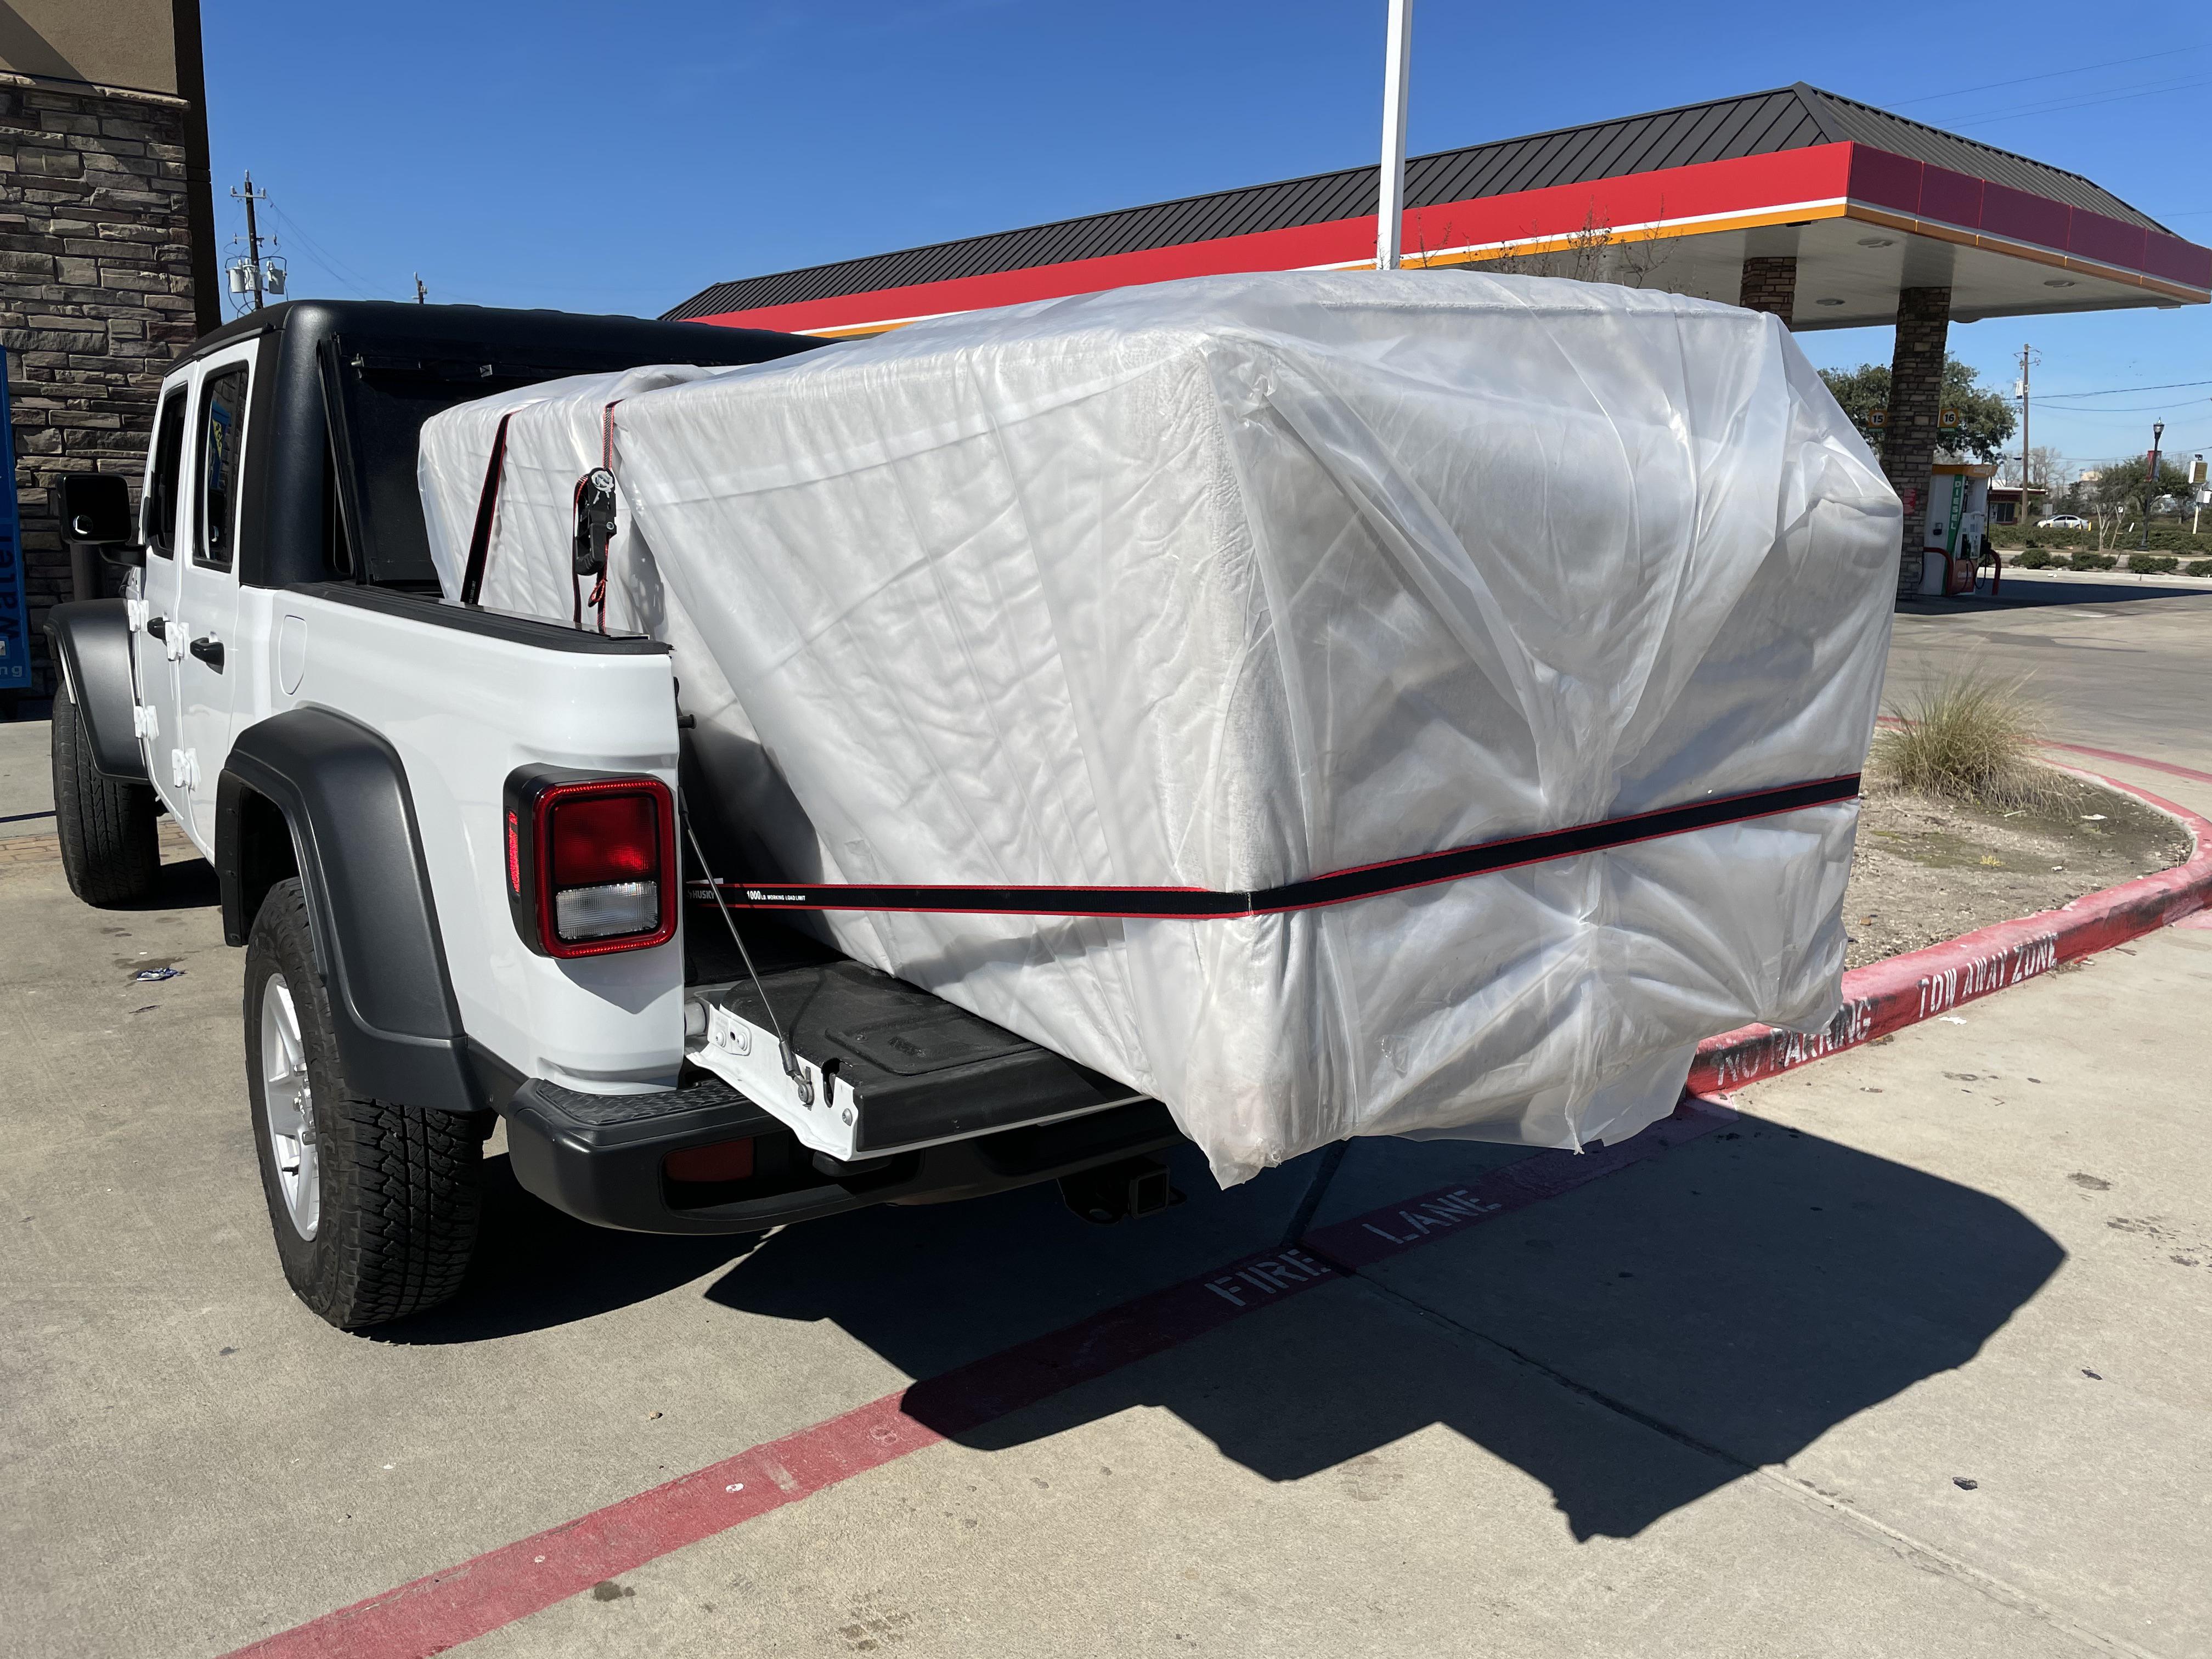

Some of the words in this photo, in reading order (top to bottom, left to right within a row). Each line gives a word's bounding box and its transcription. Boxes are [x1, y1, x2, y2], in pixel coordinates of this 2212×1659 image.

[1951, 481, 1961, 529] DIESEL
[692, 890, 714, 899] HUSKY
[747, 890, 761, 900] 1000
[1717, 1038, 1760, 1085] NO
[1917, 968, 1957, 1018] TOW
[1962, 949, 2008, 997] AWAY
[2012, 931, 2057, 984] ZONE
[1204, 1249, 1331, 1307] FIRE
[1362, 1189, 1502, 1244] LANE
